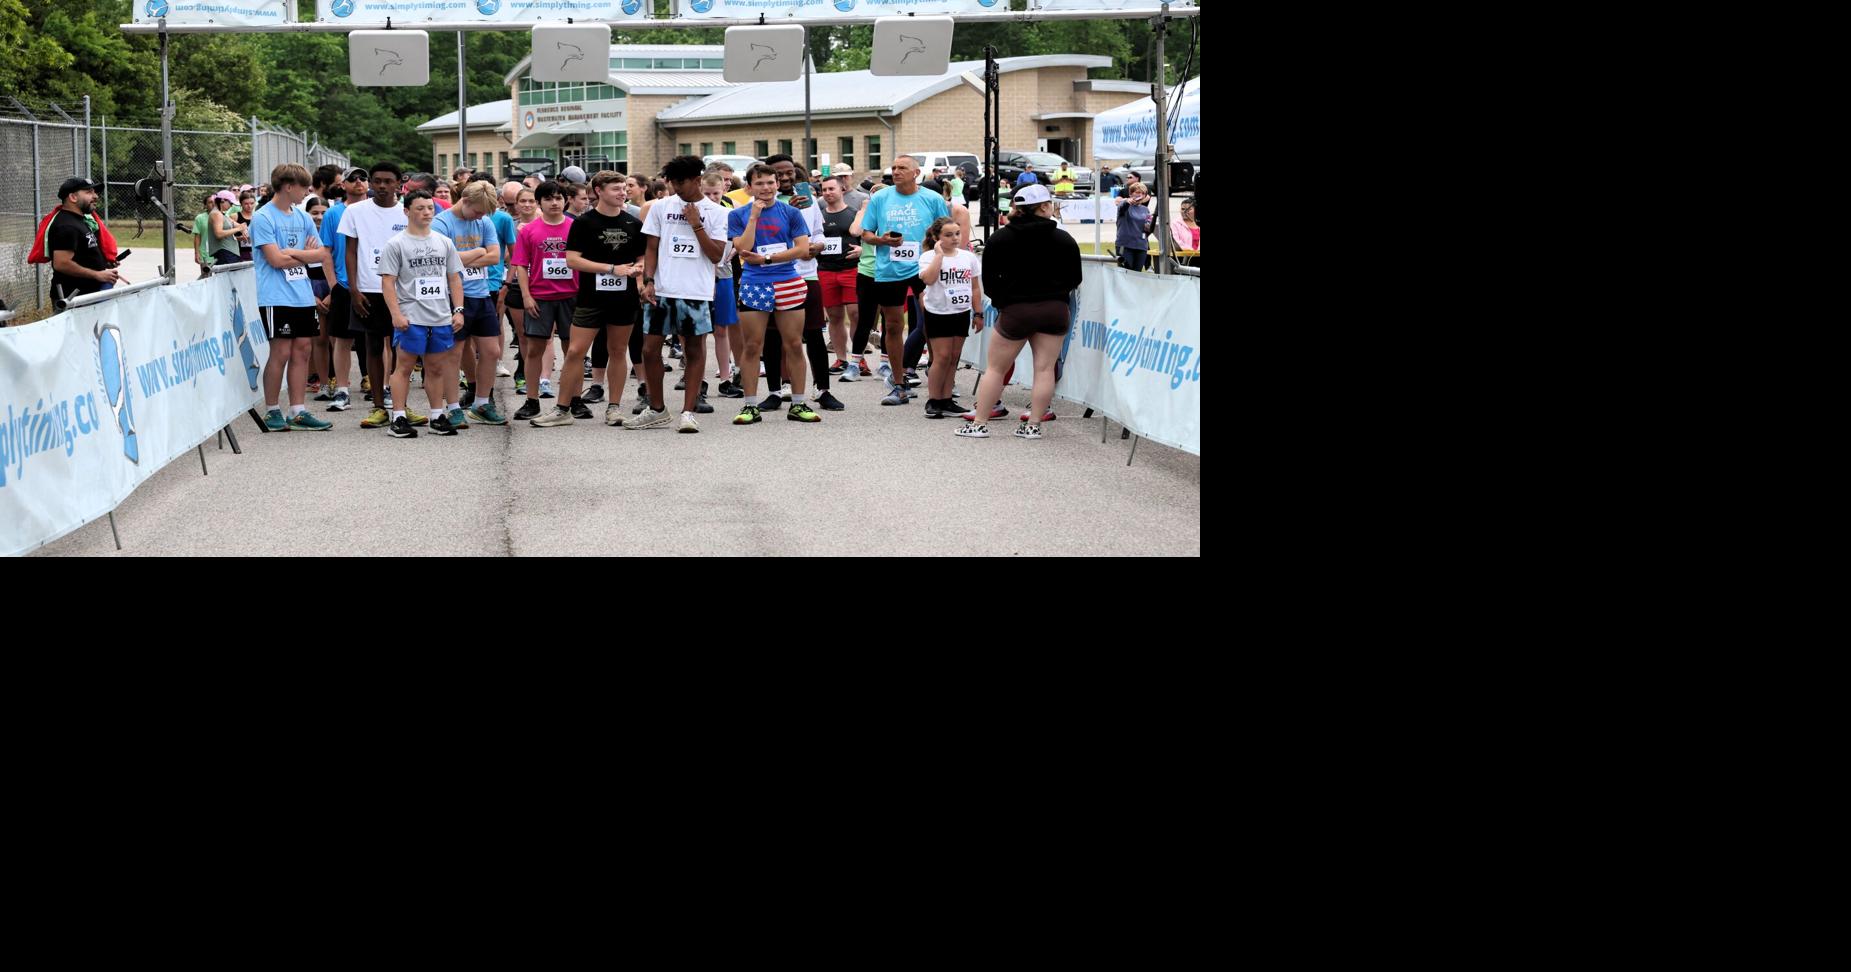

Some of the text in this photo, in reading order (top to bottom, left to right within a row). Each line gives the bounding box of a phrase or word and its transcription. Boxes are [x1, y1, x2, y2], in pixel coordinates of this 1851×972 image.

[365, 1, 466, 11] www.simplytiming.com
[510, 0, 611, 10] www.simplytiming.com
[673, 244, 694, 253] 872
[894, 249, 914, 258] 950
[287, 267, 304, 276] 842
[547, 266, 568, 275] 966
[601, 278, 622, 287] 886
[421, 286, 441, 296] 844
[951, 294, 970, 305] 852
